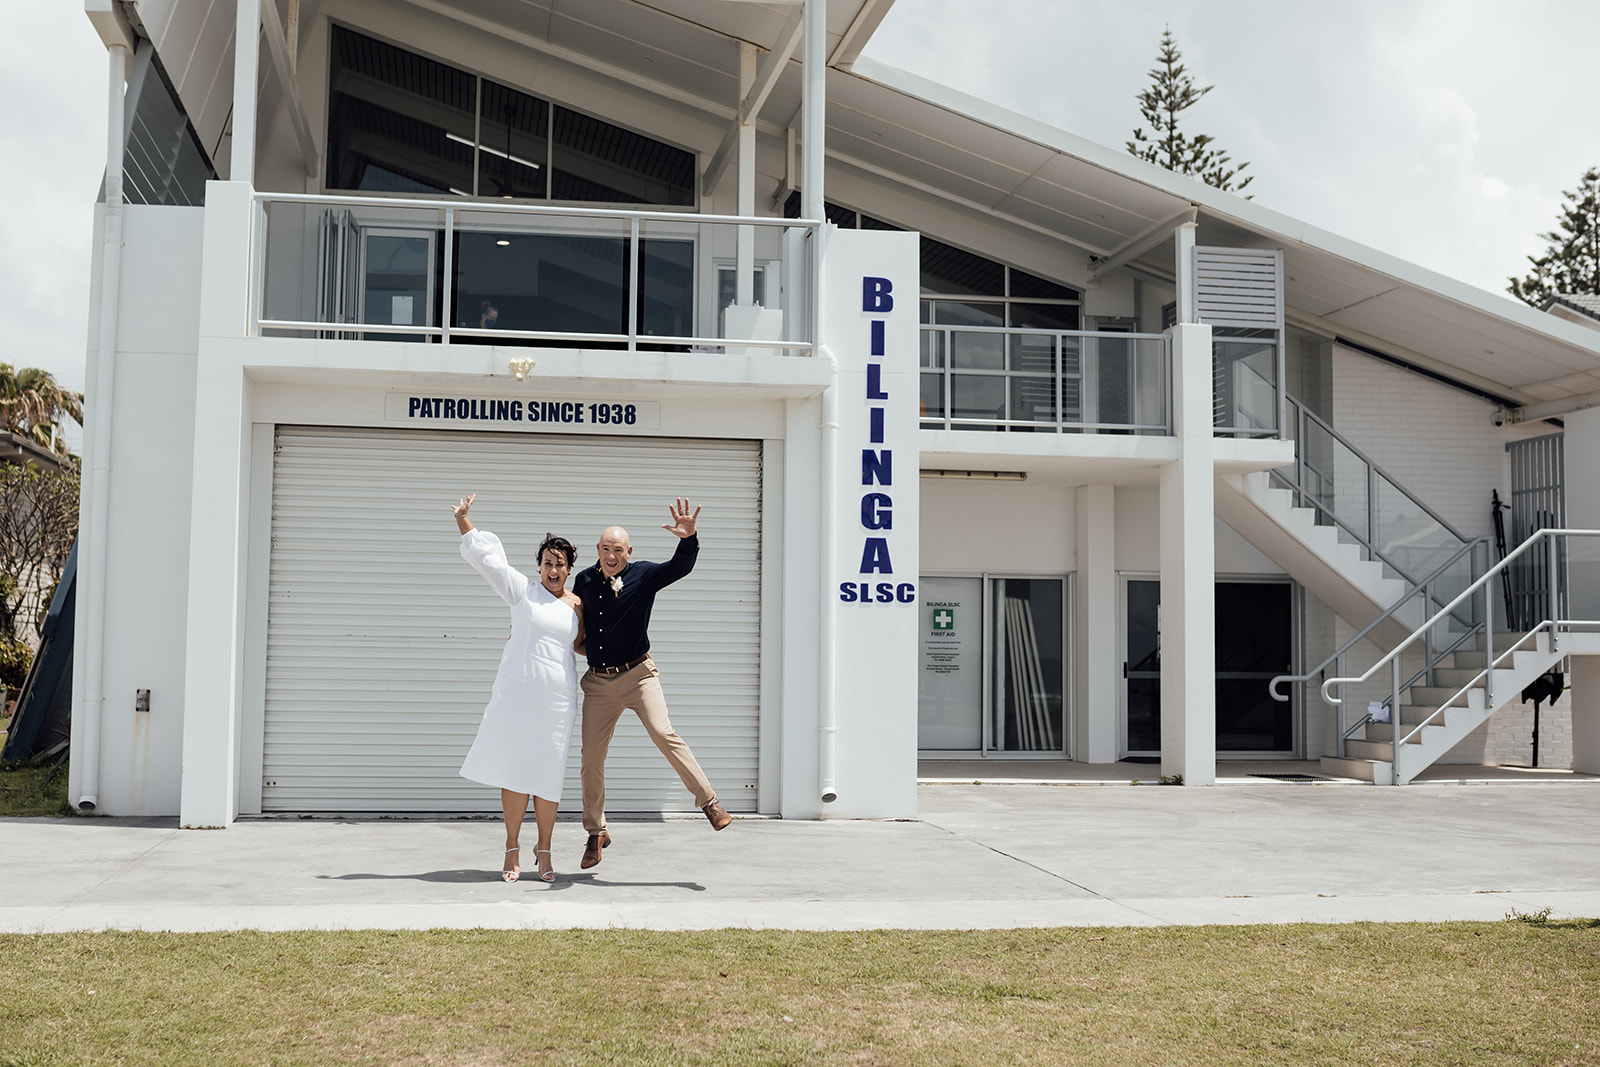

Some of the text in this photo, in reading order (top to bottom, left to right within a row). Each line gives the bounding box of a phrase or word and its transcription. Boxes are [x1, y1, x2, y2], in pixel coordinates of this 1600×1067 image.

[408, 397, 637, 425] PATROLLING SINCE 1938
[858, 276, 894, 574] BILINGA
[839, 582, 916, 604] SLSC
